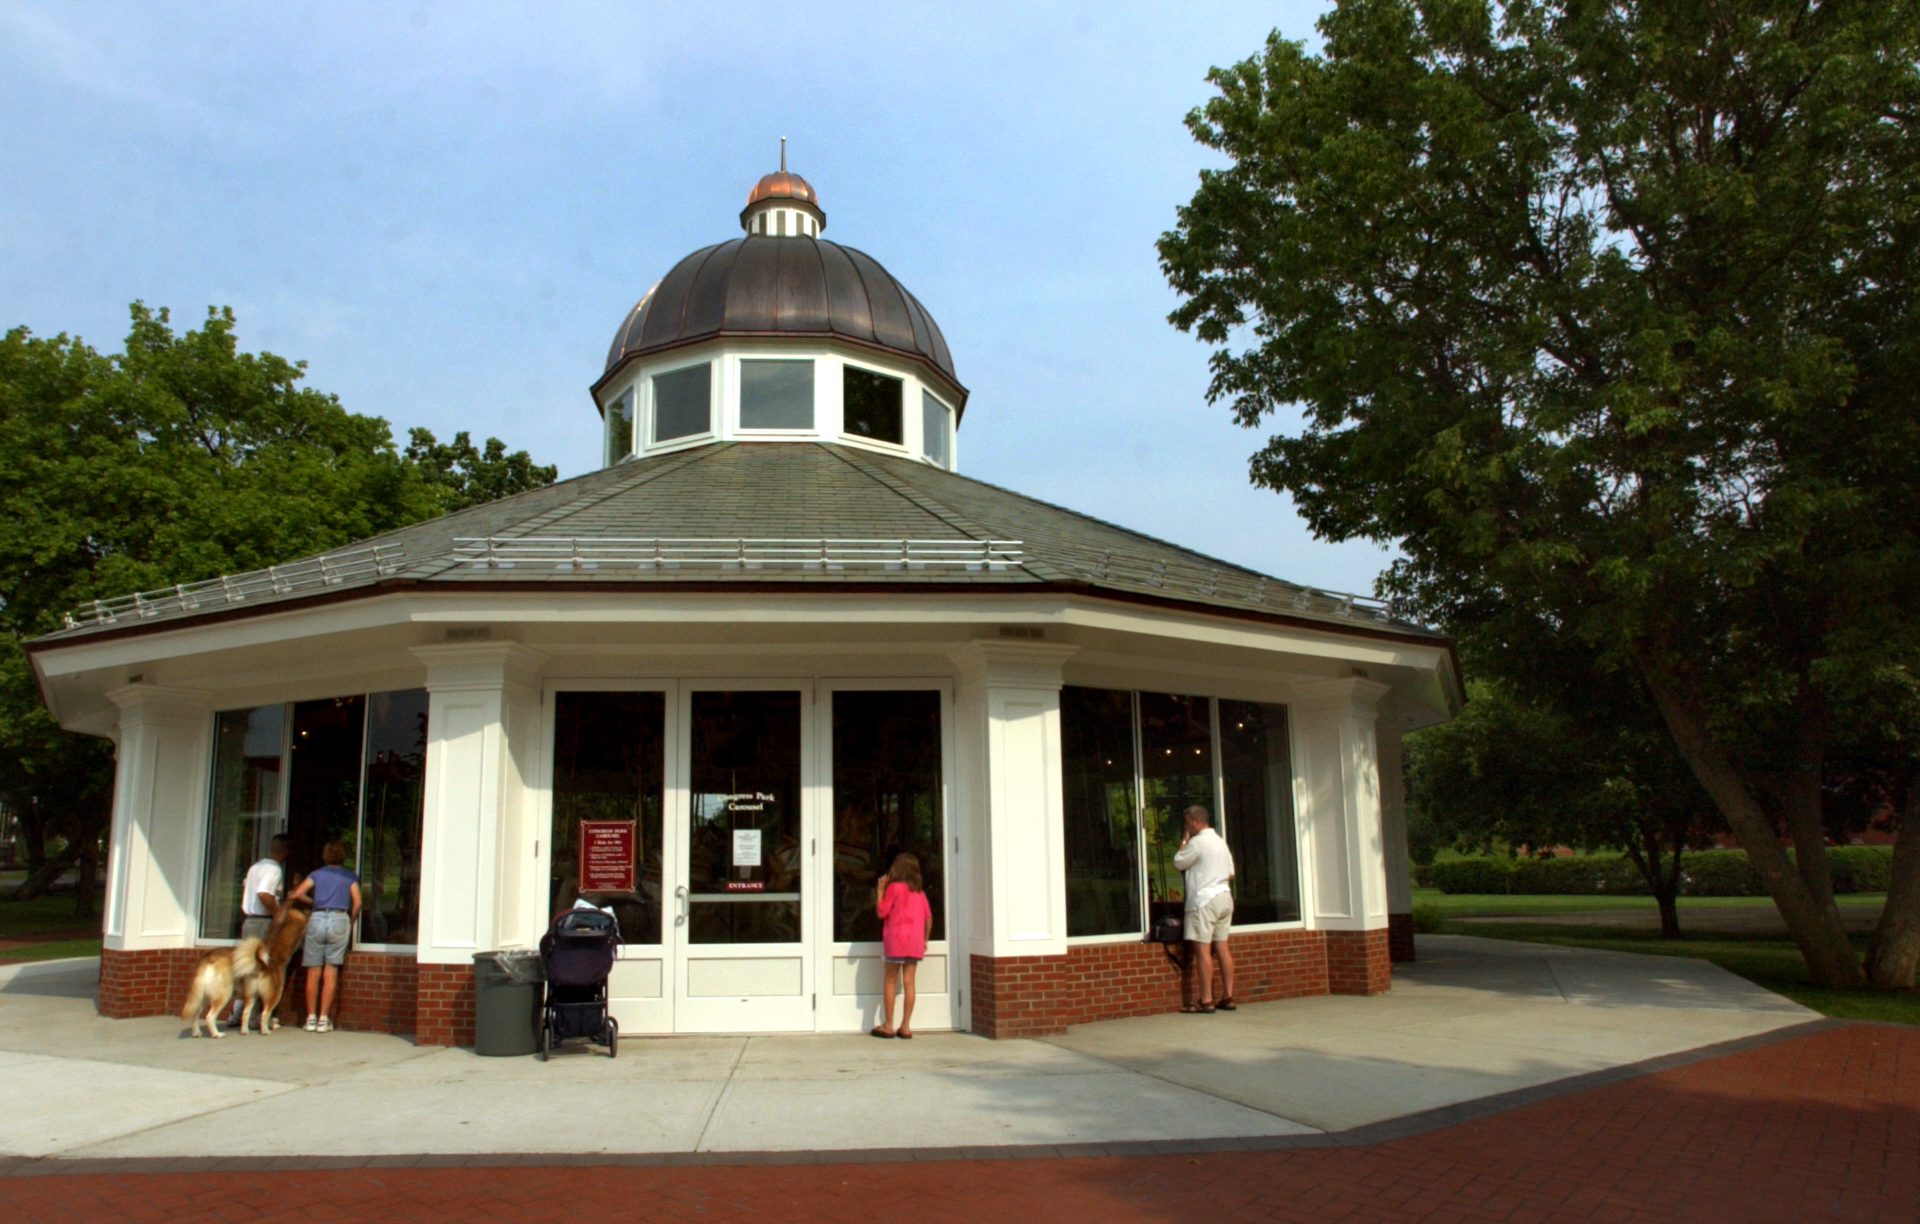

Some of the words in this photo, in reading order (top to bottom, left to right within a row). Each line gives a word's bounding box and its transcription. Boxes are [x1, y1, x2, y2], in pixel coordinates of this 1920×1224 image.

[717, 793, 753, 802] Congress
[756, 791, 775, 802] Park
[728, 803, 764, 811] Carousel
